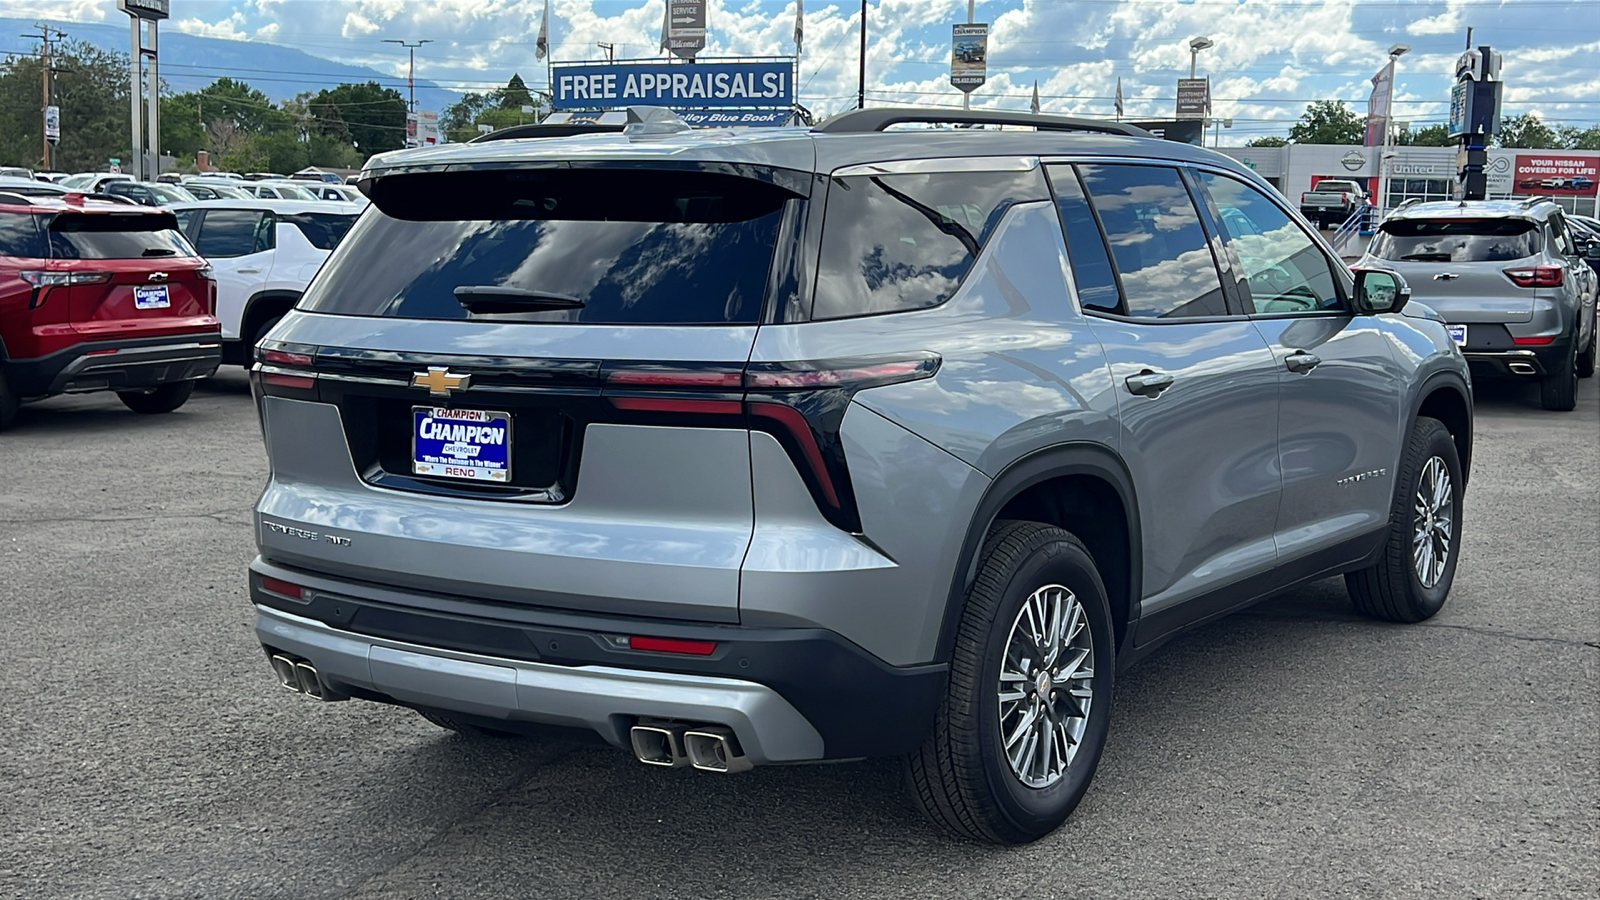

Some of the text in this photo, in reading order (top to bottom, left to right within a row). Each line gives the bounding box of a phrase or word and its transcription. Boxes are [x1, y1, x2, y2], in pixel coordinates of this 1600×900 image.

[671, 40, 699, 48] Welcome!
[560, 73, 785, 99] FREE APPRAISALS!
[708, 113, 739, 122] Blue
[1394, 164, 1434, 174] United
[437, 408, 482, 420] CHAMPION
[420, 418, 505, 445] CHAMPION
[445, 445, 478, 454] CHEVROLET
[445, 467, 475, 477] RENO
[263, 520, 318, 541] TRAVERSE
